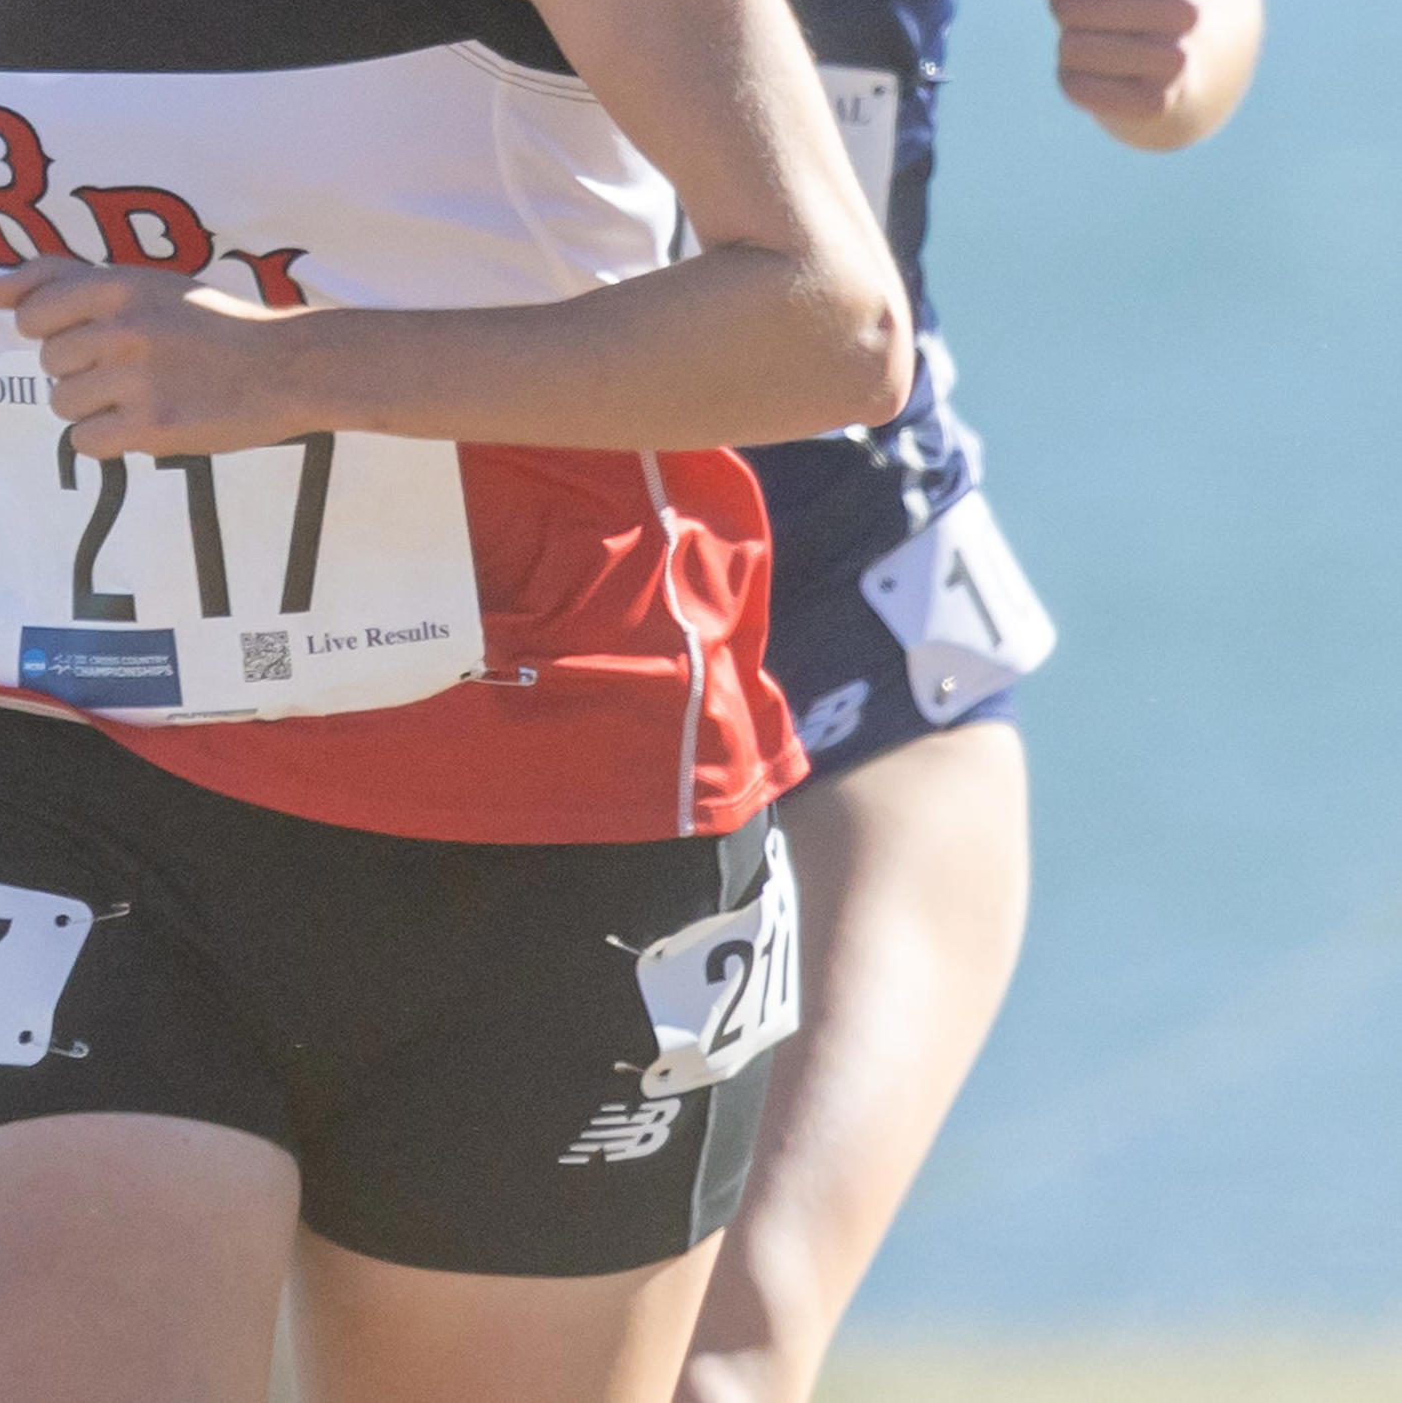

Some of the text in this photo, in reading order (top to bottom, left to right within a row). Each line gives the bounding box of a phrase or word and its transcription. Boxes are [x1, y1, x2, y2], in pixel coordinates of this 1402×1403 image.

[58, 423, 335, 622] 217
[307, 621, 450, 654] Live Results
